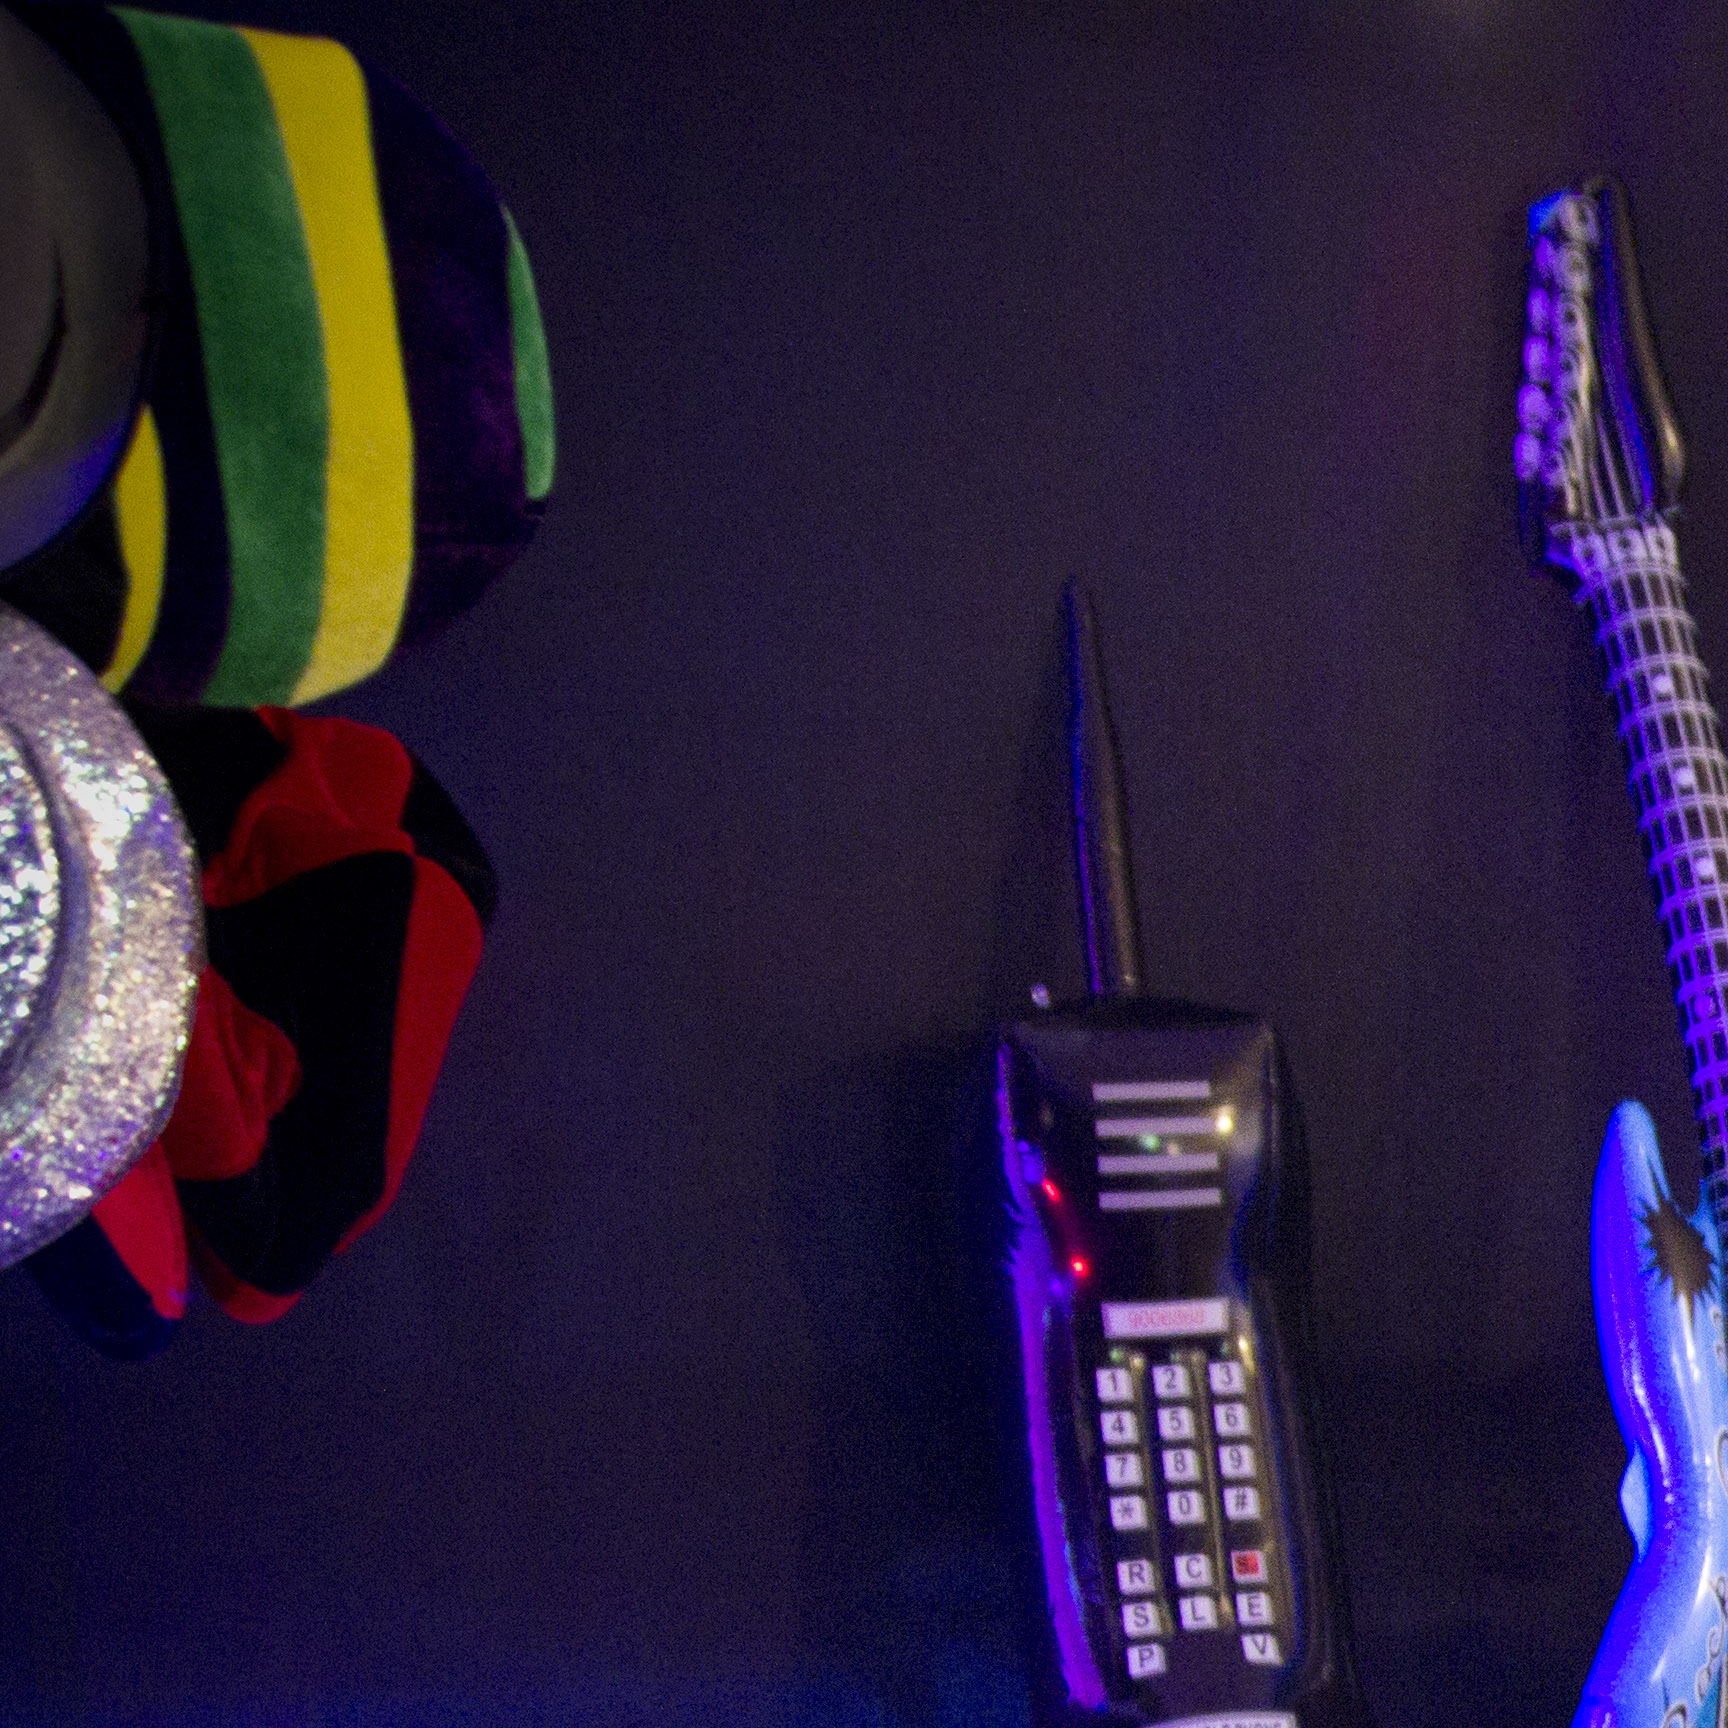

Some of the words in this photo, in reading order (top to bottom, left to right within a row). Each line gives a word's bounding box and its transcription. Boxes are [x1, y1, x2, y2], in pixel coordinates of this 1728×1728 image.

[1163, 1367, 1177, 1390] 2
[1219, 1364, 1233, 1387] 3
[1111, 1414, 1125, 1435] 4
[1168, 1410, 1182, 1432] 5
[1224, 1405, 1238, 1428] 6
[1115, 1455, 1128, 1479] 7
[1173, 1451, 1186, 1474] 8
[1228, 1448, 1243, 1471] 9
[1178, 1494, 1192, 1516] 0
[1127, 1562, 1146, 1585] R
[1185, 1556, 1202, 1579] C
[1133, 1605, 1150, 1628] S
[1190, 1599, 1205, 1622] L
[1247, 1595, 1263, 1617] E
[1137, 1647, 1154, 1669] P
[1252, 1637, 1268, 1656] V
